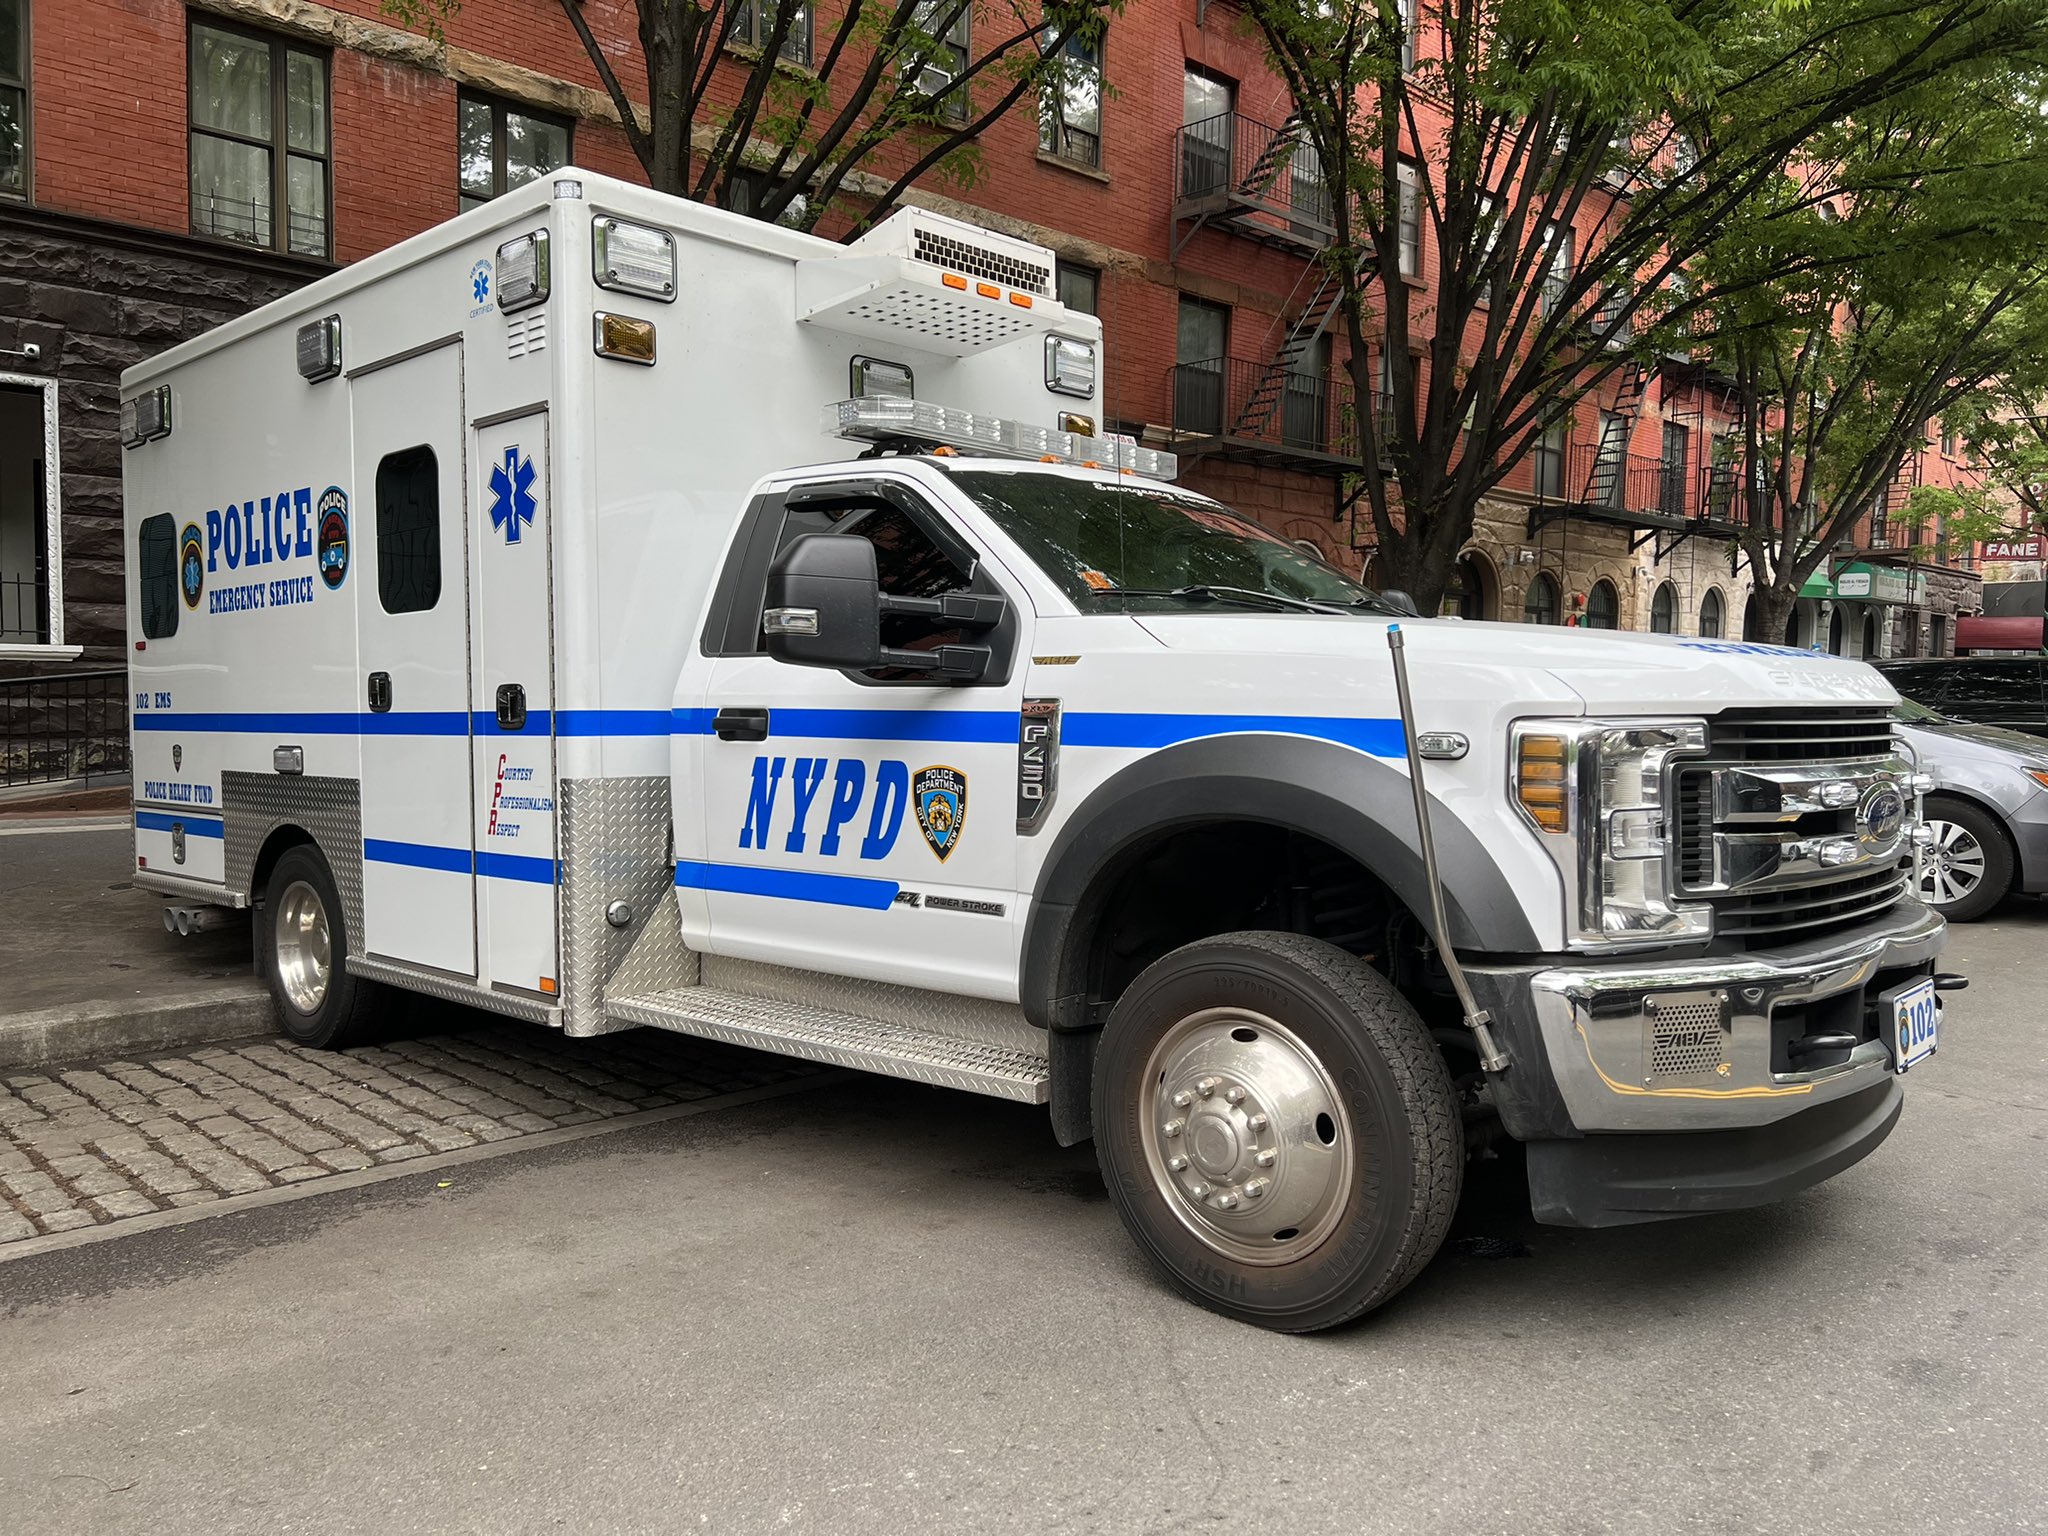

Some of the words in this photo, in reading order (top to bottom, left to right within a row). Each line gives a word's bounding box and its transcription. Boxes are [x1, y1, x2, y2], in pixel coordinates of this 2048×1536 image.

[470, 303, 493, 318] CERTIFIED
[320, 492, 347, 520] POLICE
[206, 487, 313, 573] POLICE
[1986, 543, 2039, 557] FANE
[209, 583, 266, 614] EMERGENCY
[269, 576, 313, 607] SERVICE
[135, 693, 149, 709] 102
[155, 692, 171, 708] EMS
[497, 754, 534, 780] COURTESY
[925, 769, 954, 780] POLICE
[144, 781, 167, 800] POLICE
[169, 783, 192, 802] RELIEF
[194, 785, 213, 804] FUND
[492, 782, 554, 811] PROFESSIONALISM
[916, 779, 964, 795] DEPARTMENT
[739, 756, 909, 860] NYPD
[488, 809, 520, 837] RESPECT
[917, 806, 927, 827] CITY
[925, 830, 935, 842] OF
[946, 830, 958, 848] NEW
[954, 803, 964, 829] YORK
[926, 896, 960, 907] POWER
[962, 900, 1002, 912] STROKE
[1910, 997, 1934, 1046] 102
